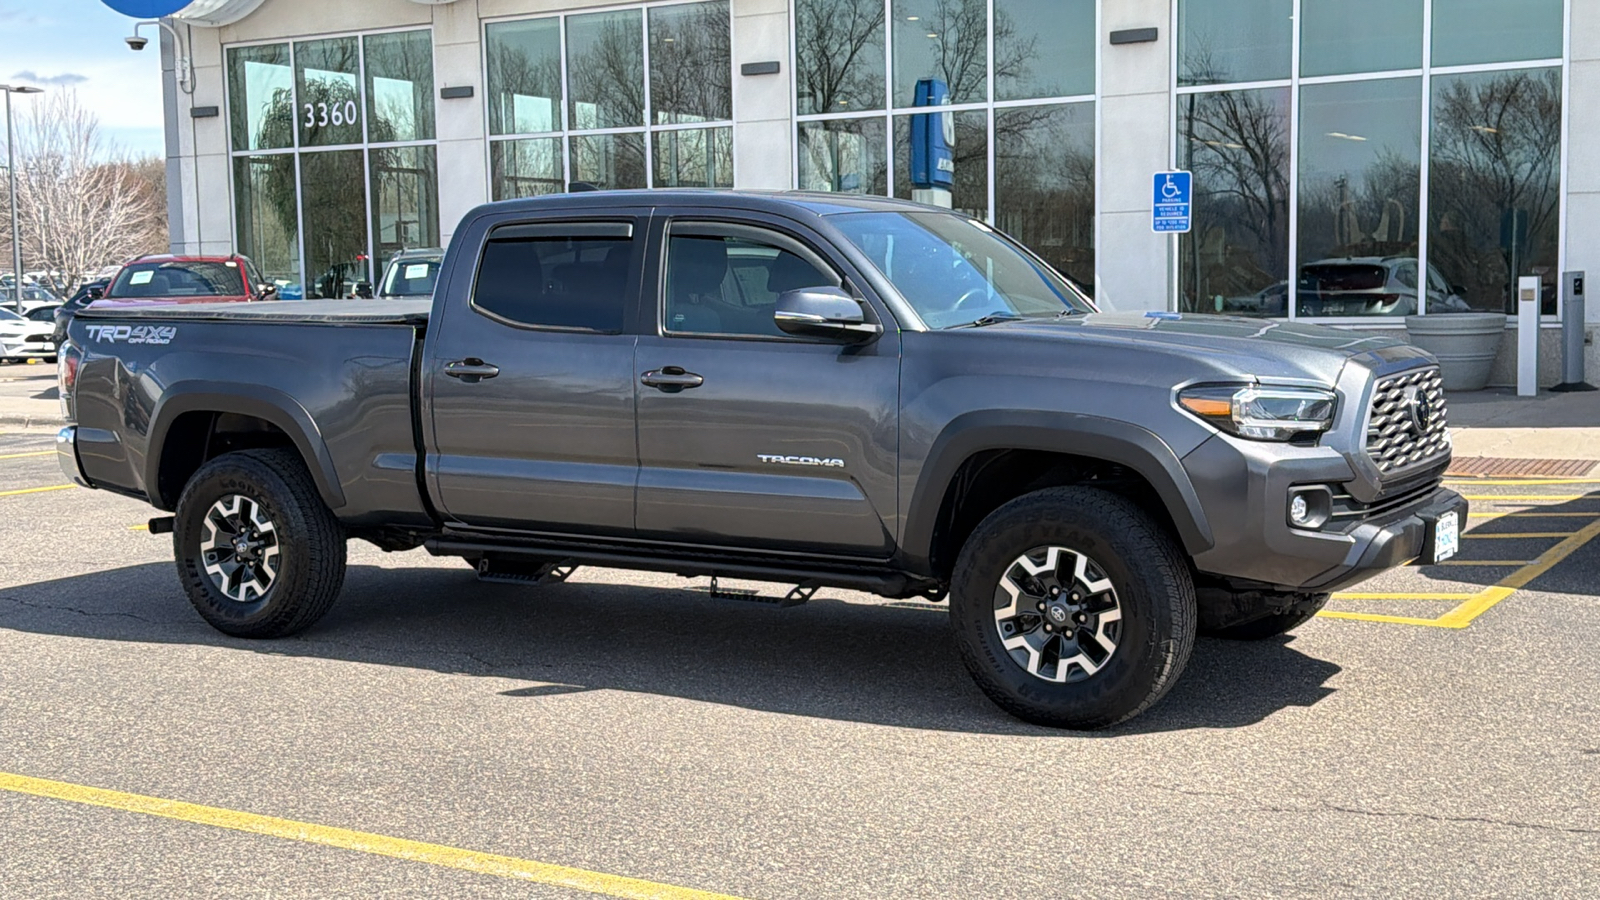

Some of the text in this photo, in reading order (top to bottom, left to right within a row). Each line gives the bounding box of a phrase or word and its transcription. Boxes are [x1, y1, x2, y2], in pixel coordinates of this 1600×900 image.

[304, 100, 357, 128] 3360
[85, 325, 132, 343] TRD
[757, 454, 845, 468] TACOMA
